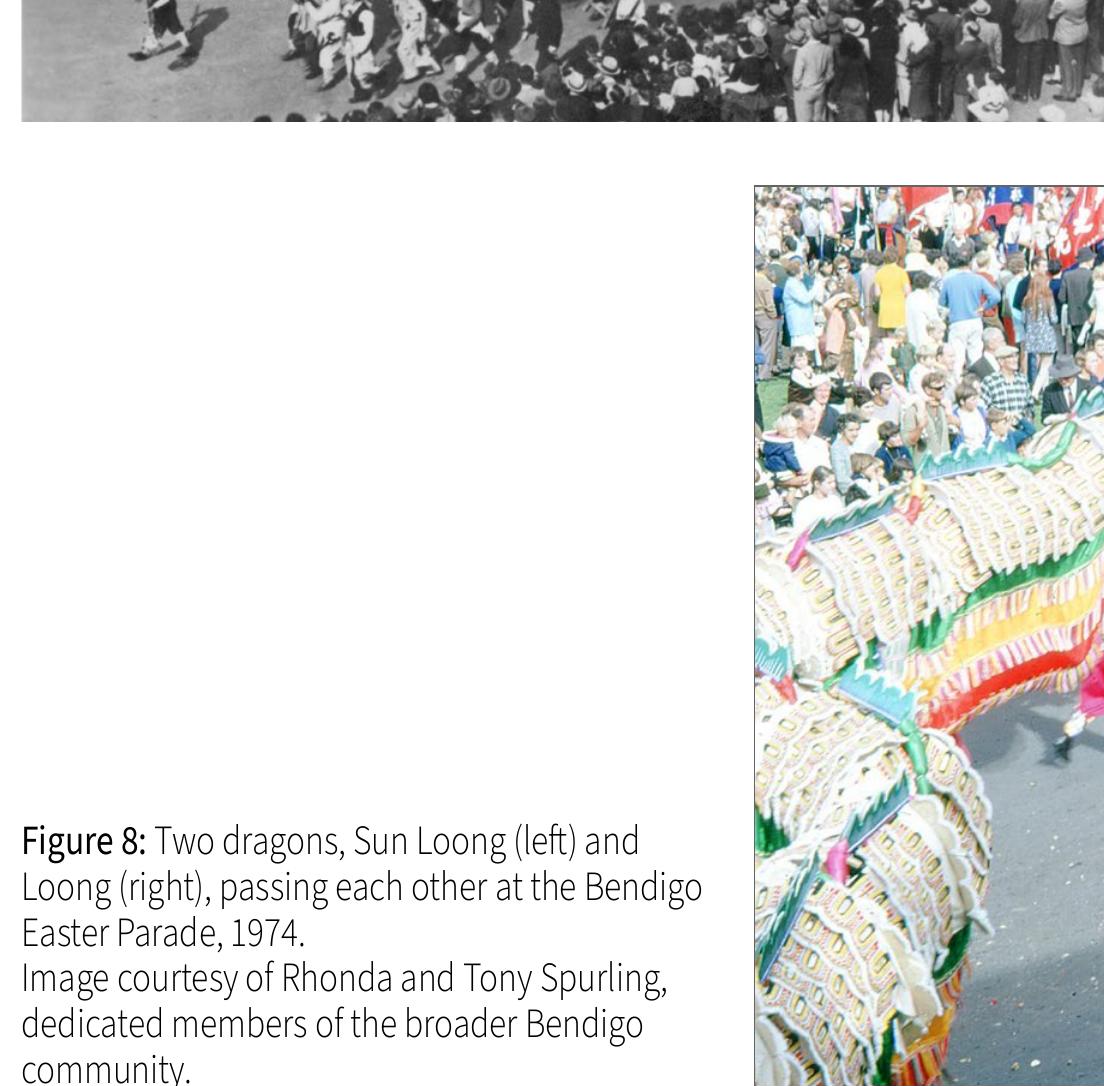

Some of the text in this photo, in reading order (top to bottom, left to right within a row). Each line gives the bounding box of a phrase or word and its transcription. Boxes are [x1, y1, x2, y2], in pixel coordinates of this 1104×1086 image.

[23, 822, 638, 865] Figure 8: Two dragons, Sun Loong (left) and
[23, 869, 702, 911] Loong (right), passing each other at the Bendigo
[23, 915, 305, 953] Easter Parade, 1974.
[23, 959, 667, 1002] Image courtesy of Rhonda and Tony Spurling,
[22, 1005, 643, 1048] dedicated members of the broader Bendigo
